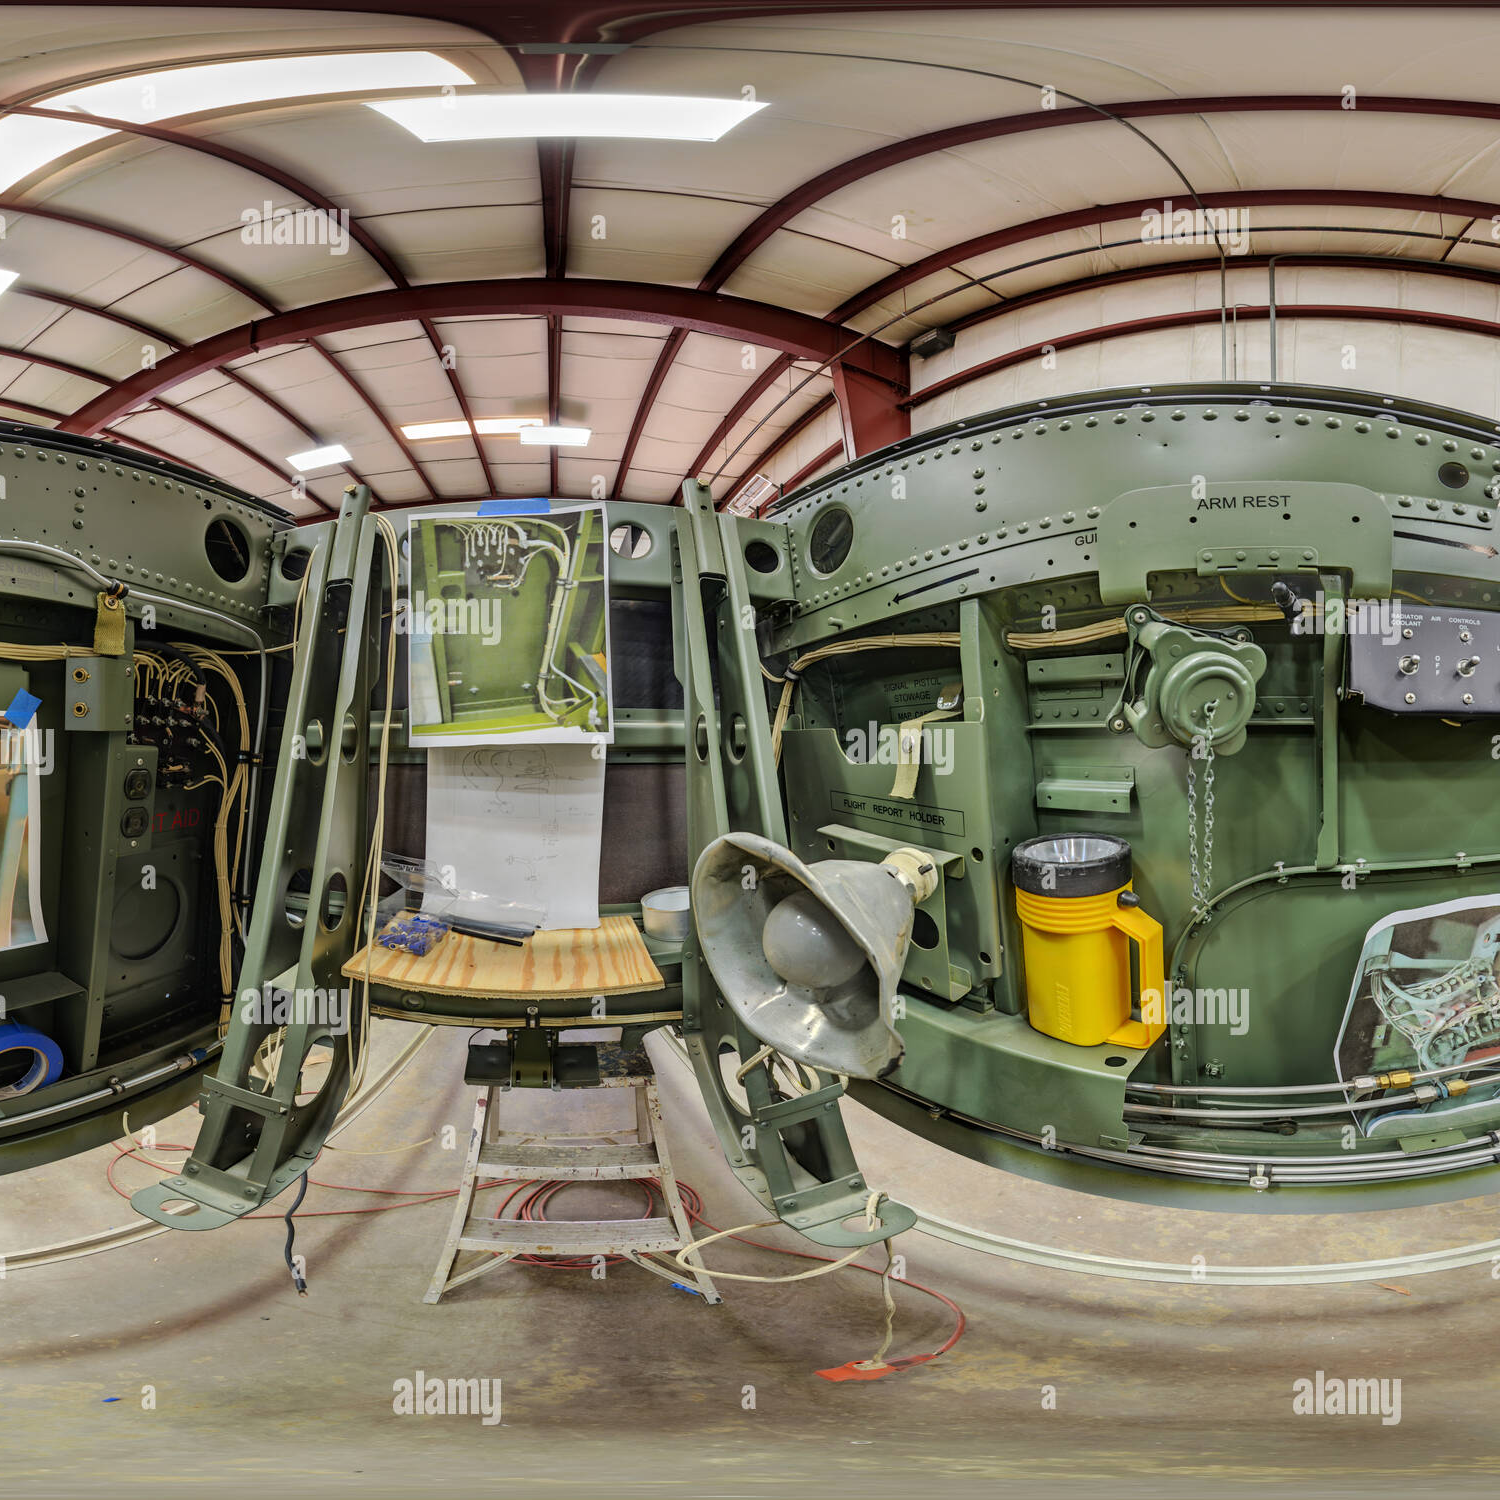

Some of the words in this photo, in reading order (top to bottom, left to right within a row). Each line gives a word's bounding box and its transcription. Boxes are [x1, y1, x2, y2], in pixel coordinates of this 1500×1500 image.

[1197, 496, 1236, 510] ARM
[1243, 495, 1291, 508] REST
[1391, 613, 1423, 621] RADIATOR
[1449, 617, 1481, 625] CONTROLS
[1391, 619, 1421, 627] COOLANT
[884, 680, 908, 692] SIGNAL
[914, 677, 942, 688] PISTOL
[894, 690, 931, 703] STOWAGE
[898, 712, 912, 720] MAP
[170, 807, 202, 830] AID
[843, 799, 866, 810] FLIGHT
[873, 804, 903, 817] REPORT
[910, 811, 945, 826] HOLDER
